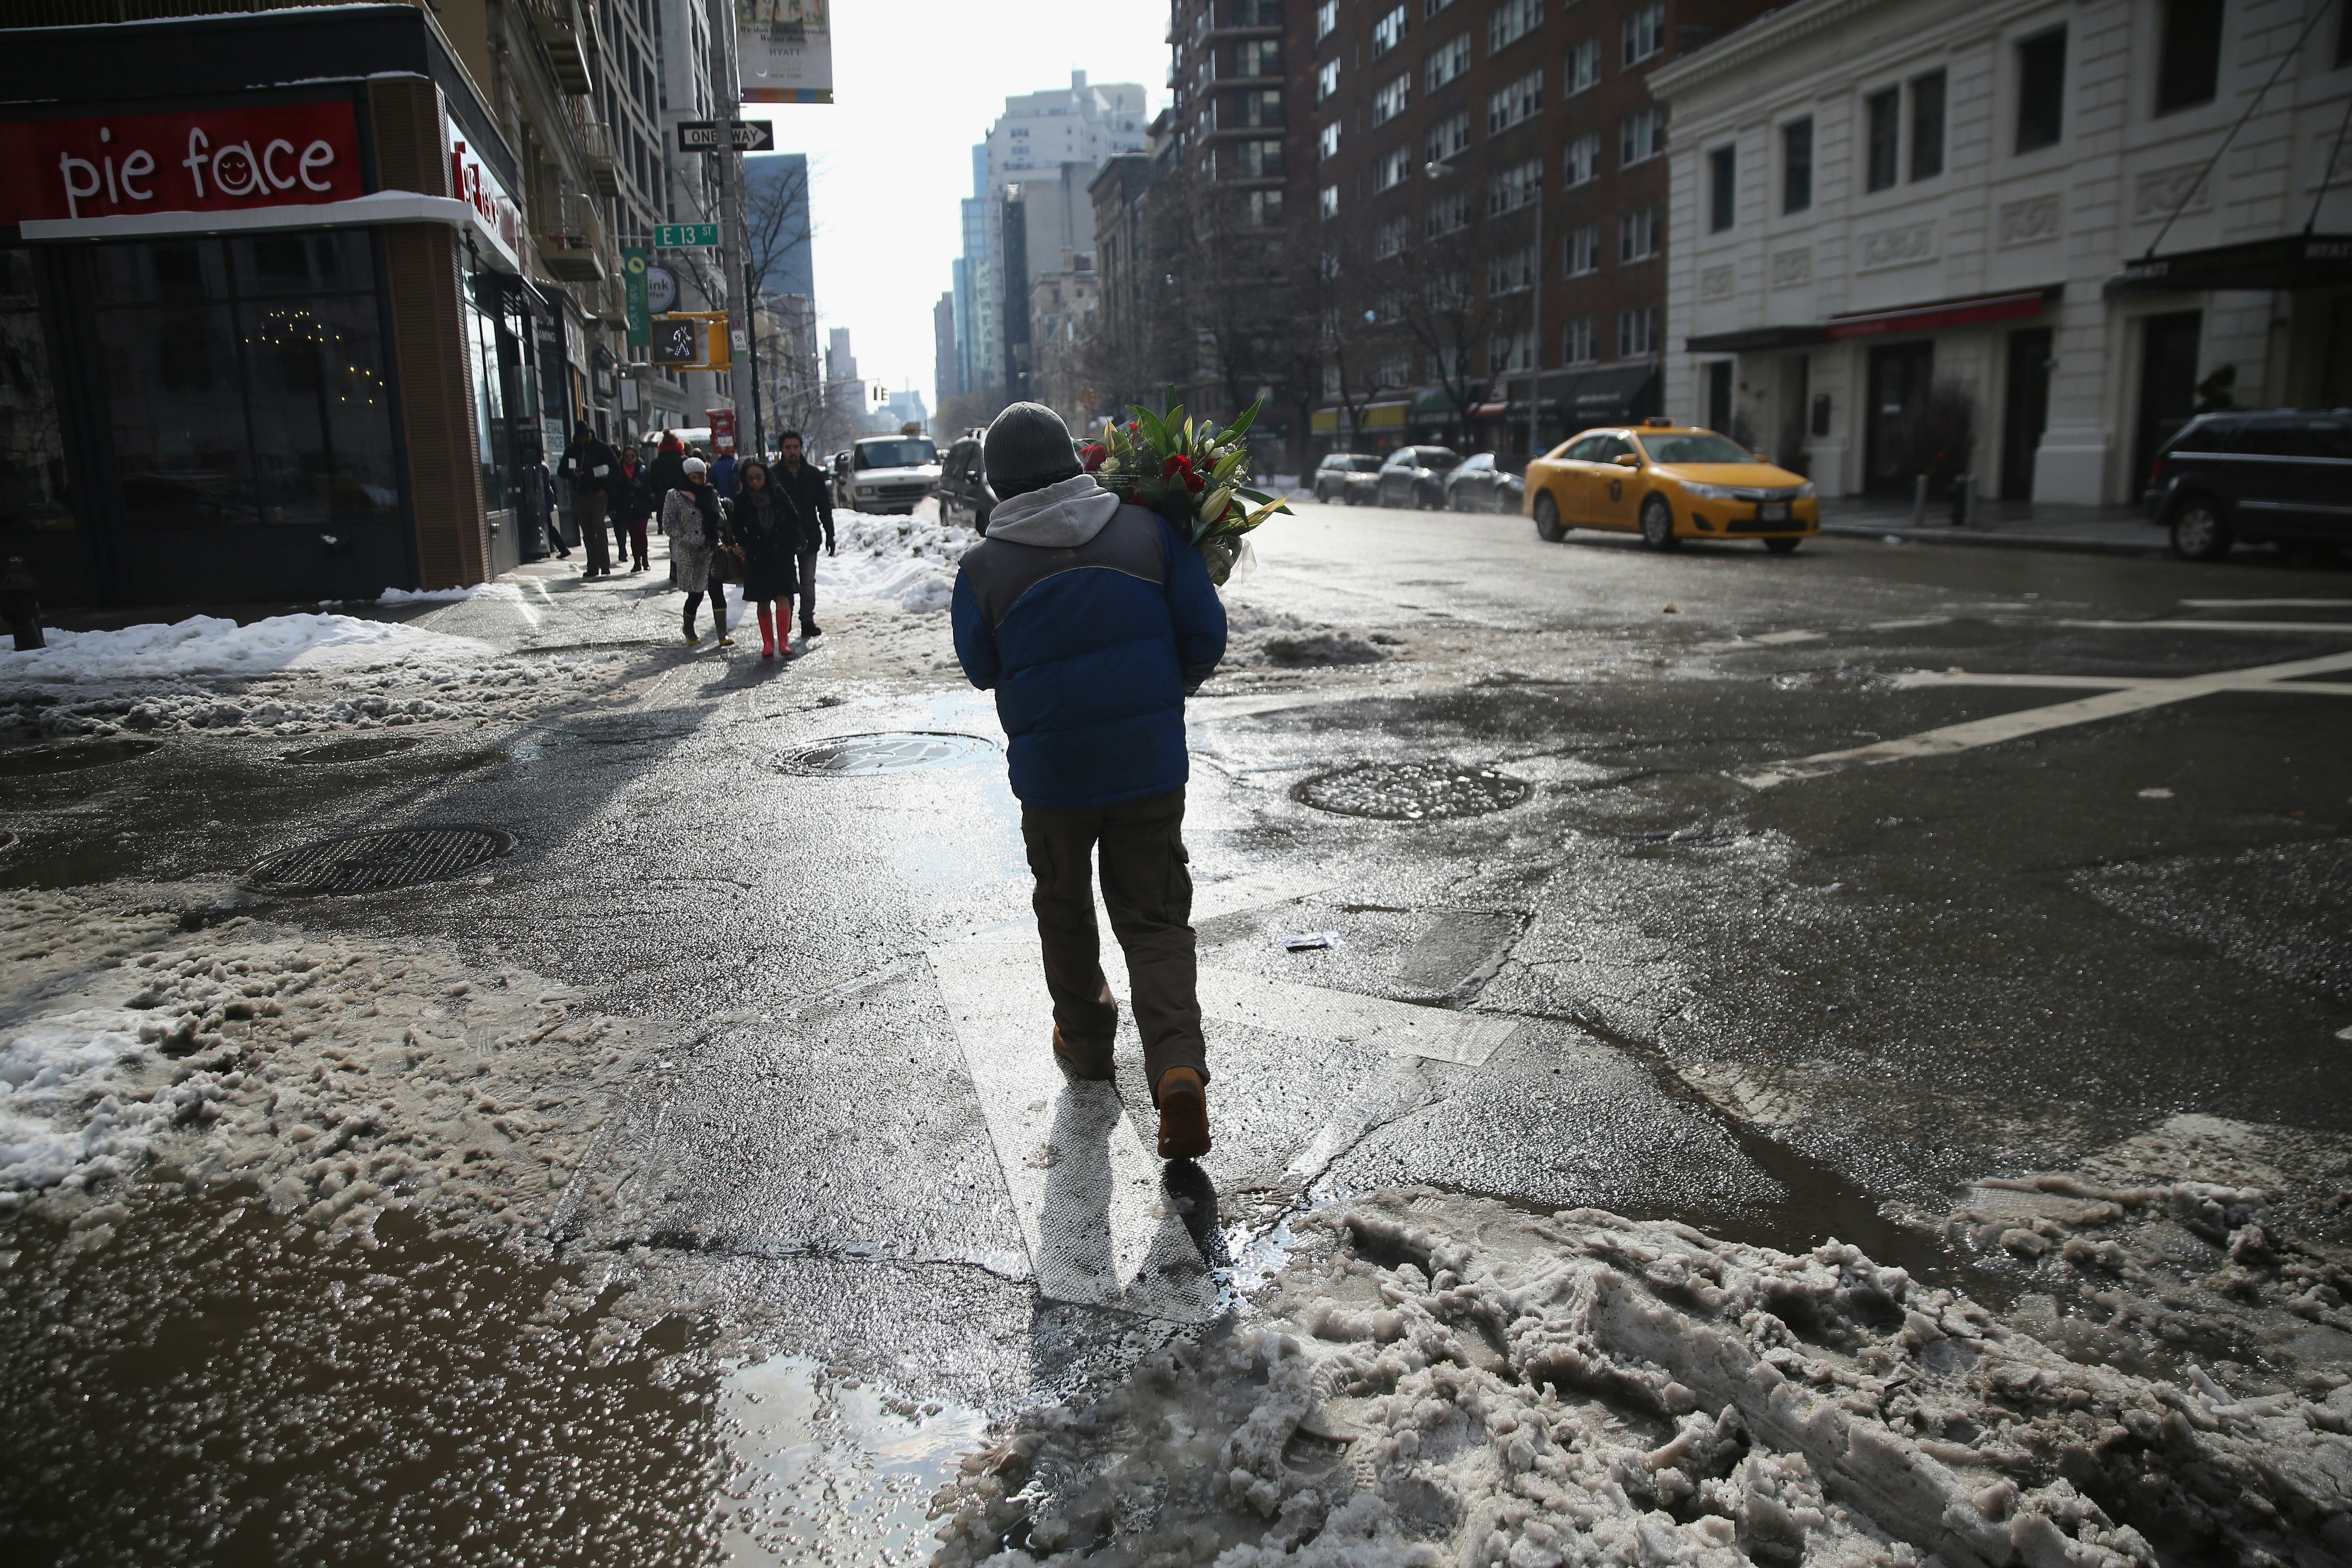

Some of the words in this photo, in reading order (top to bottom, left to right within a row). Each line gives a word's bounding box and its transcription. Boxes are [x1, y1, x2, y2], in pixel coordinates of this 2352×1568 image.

[770, 48, 800, 56] HYATT
[692, 130, 717, 143] ONE
[732, 129, 758, 142] WAY
[59, 127, 155, 218] pie
[183, 127, 335, 198] face
[663, 227, 673, 245] E
[680, 226, 696, 245] 13
[702, 225, 712, 236] ST
[2305, 241, 2352, 259] HYAT
[650, 278, 669, 290] ink
[539, 330, 556, 343] AMING
[545, 421, 562, 434] ETAIL
[546, 435, 564, 448] PACE
